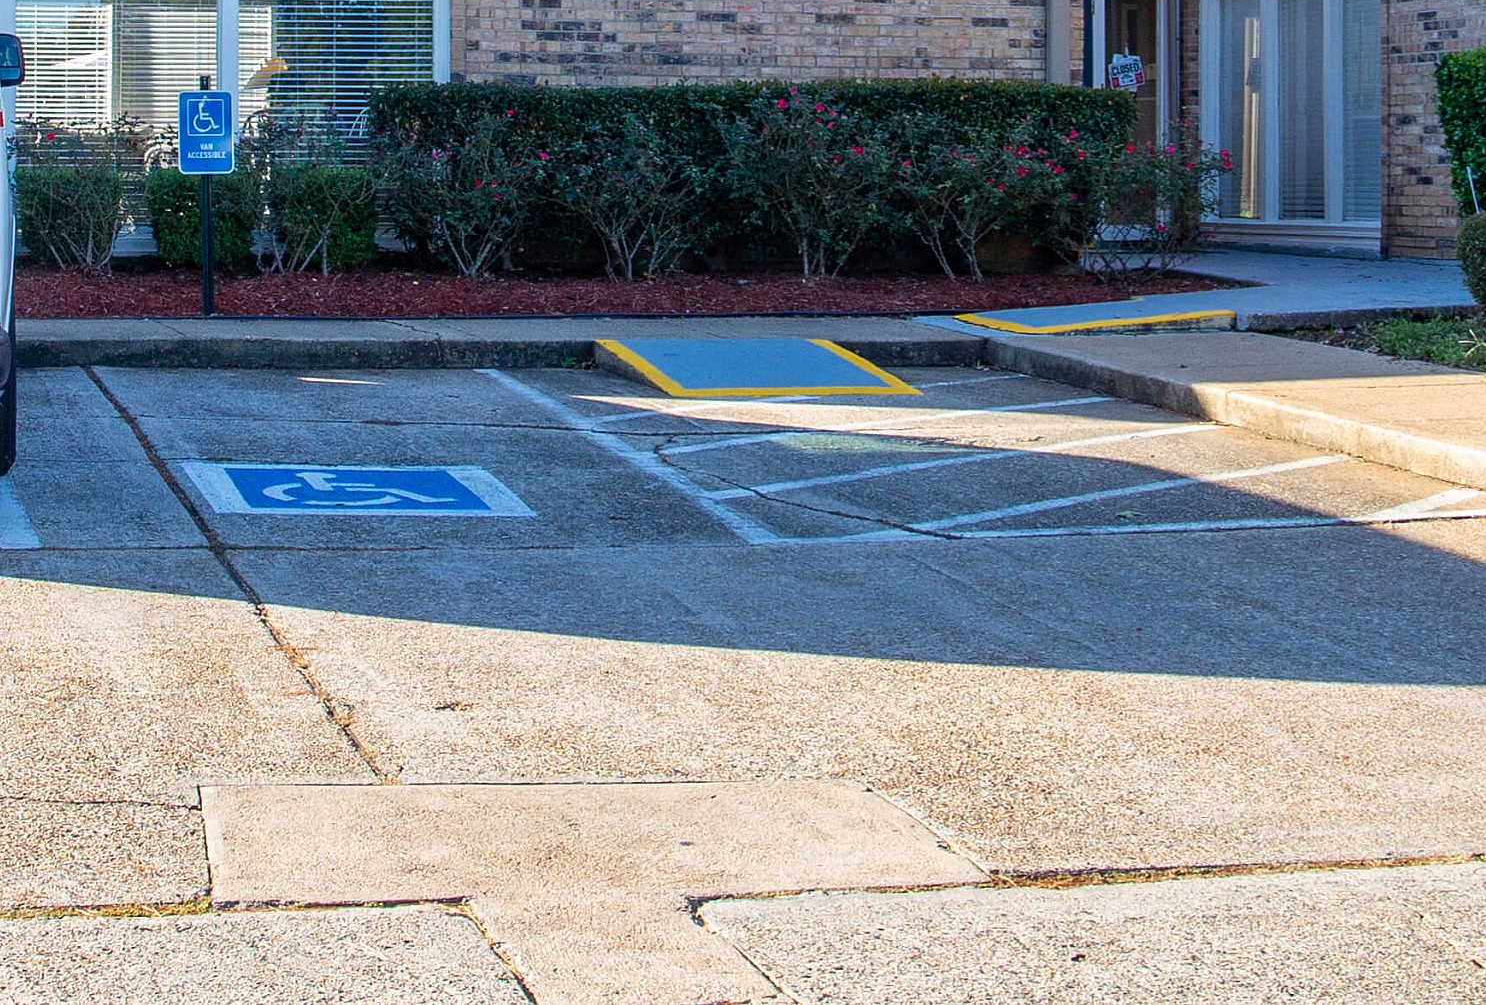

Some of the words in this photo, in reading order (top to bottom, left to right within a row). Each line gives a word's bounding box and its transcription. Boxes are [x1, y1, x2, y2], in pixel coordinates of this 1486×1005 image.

[1111, 62, 1140, 76] CLOSED
[200, 142, 214, 150] VAN
[187, 151, 227, 159] ACCESSIBLE
